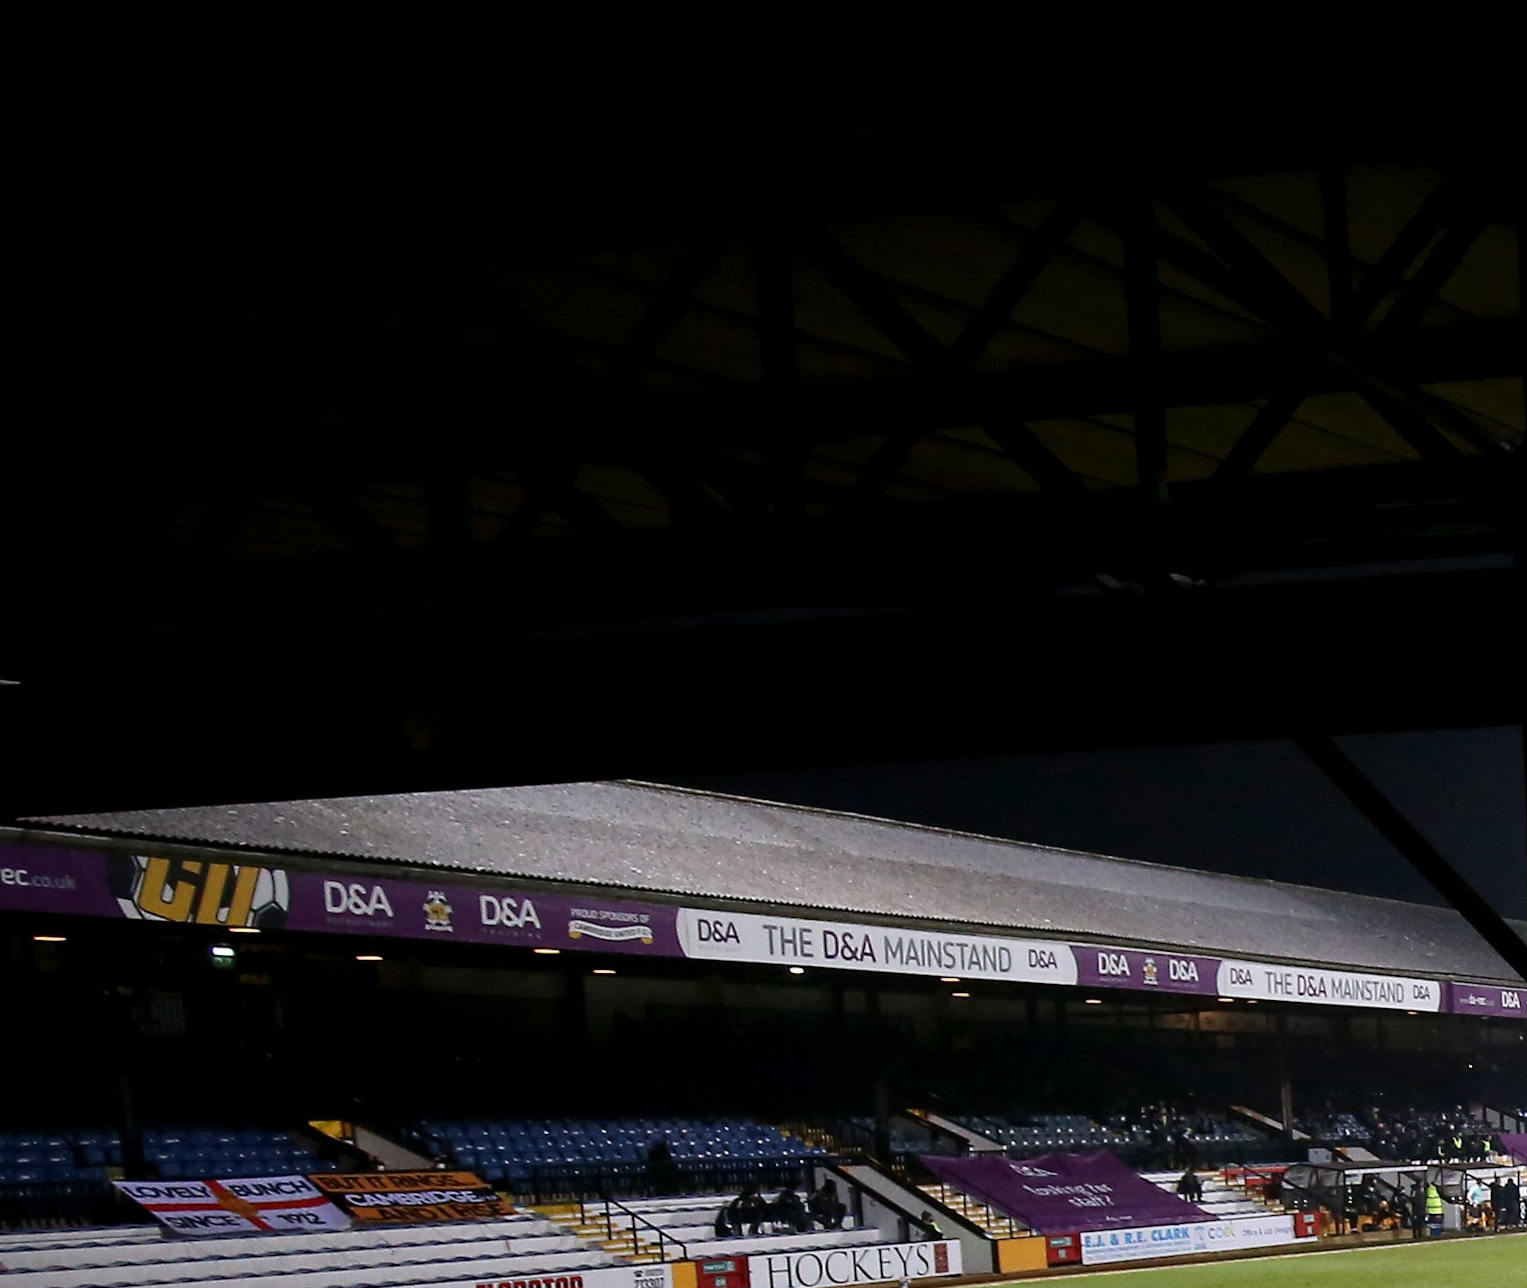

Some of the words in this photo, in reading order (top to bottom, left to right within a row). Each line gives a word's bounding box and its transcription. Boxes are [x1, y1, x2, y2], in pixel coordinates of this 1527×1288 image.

[138, 856, 260, 927] CU
[324, 880, 394, 917] D&A
[480, 895, 541, 929] D&A
[698, 919, 740, 944] D&A
[763, 924, 814, 958] THE
[823, 930, 877, 963] D&A
[884, 937, 1012, 973] MAINSTAND
[1028, 949, 1058, 970] D&A
[1098, 952, 1131, 978] D&A
[1169, 959, 1199, 983] D&A
[1230, 967, 1253, 986] D&A
[1265, 970, 1293, 996] THE
[1297, 974, 1327, 999] D&A
[1330, 978, 1404, 1004] MAINSTAND
[1412, 984, 1430, 1001] D&A
[1498, 990, 1519, 1008] D&A
[122, 1184, 212, 1200] LOVELY
[229, 1180, 311, 1197] BUNCH
[319, 1176, 365, 1190] BUT
[164, 1214, 241, 1230] SINCE
[276, 1212, 327, 1227] 1912
[379, 1206, 434, 1220] AND
[1151, 1226, 1191, 1242] CLARK
